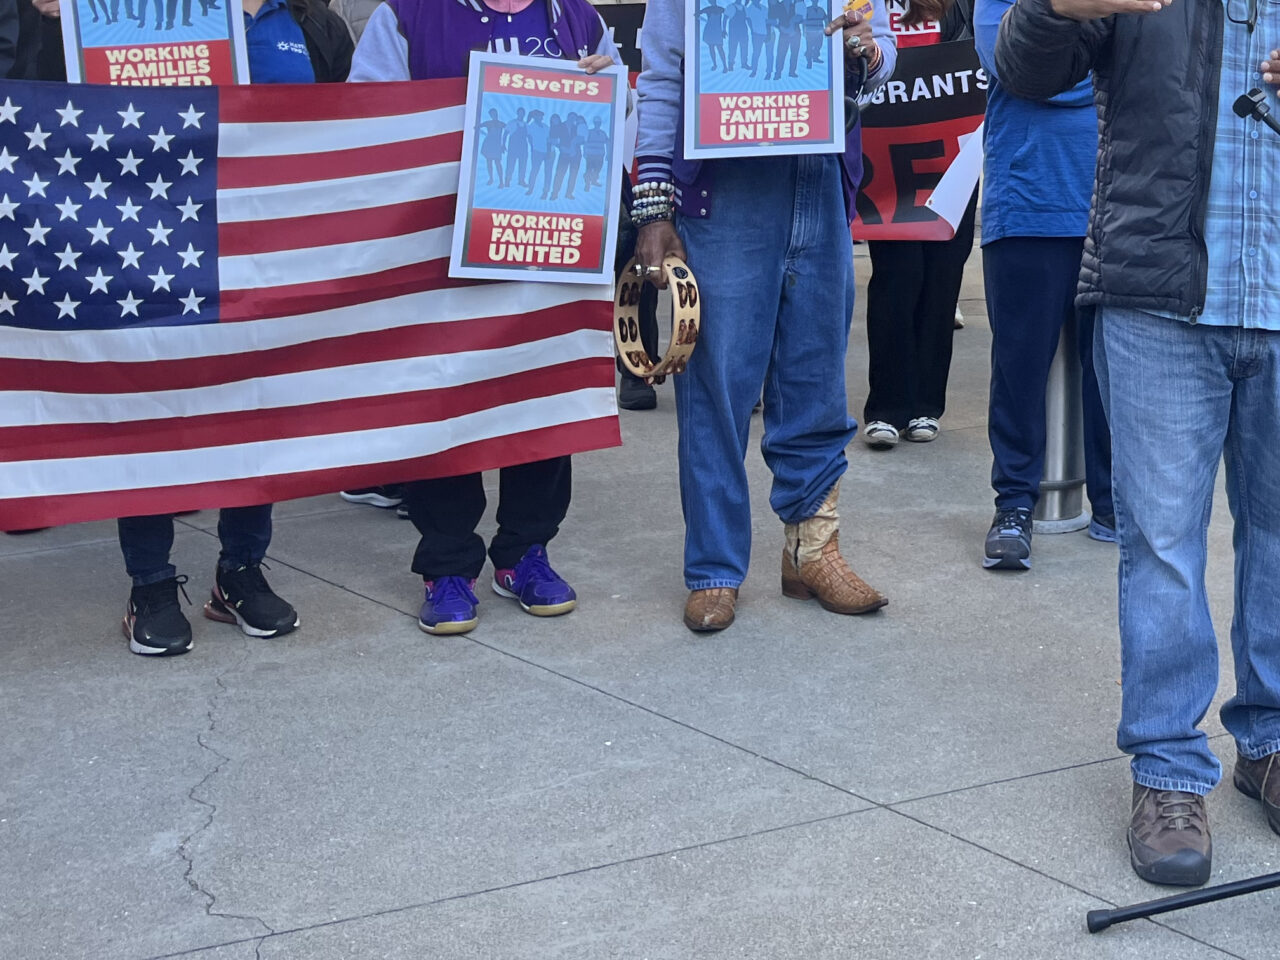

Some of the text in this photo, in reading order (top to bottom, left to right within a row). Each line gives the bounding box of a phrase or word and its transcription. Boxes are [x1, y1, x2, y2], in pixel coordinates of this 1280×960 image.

[105, 44, 209, 64] WORKING
[109, 59, 210, 80] FAMILIES
[499, 72, 599, 96] #SaveTPS
[719, 94, 810, 108] WORKING
[720, 107, 809, 123] FAMILIES
[719, 123, 810, 140] UNITED
[491, 213, 584, 231] WORKING
[491, 228, 582, 247] FAMILIES
[488, 243, 580, 264] UNITED
